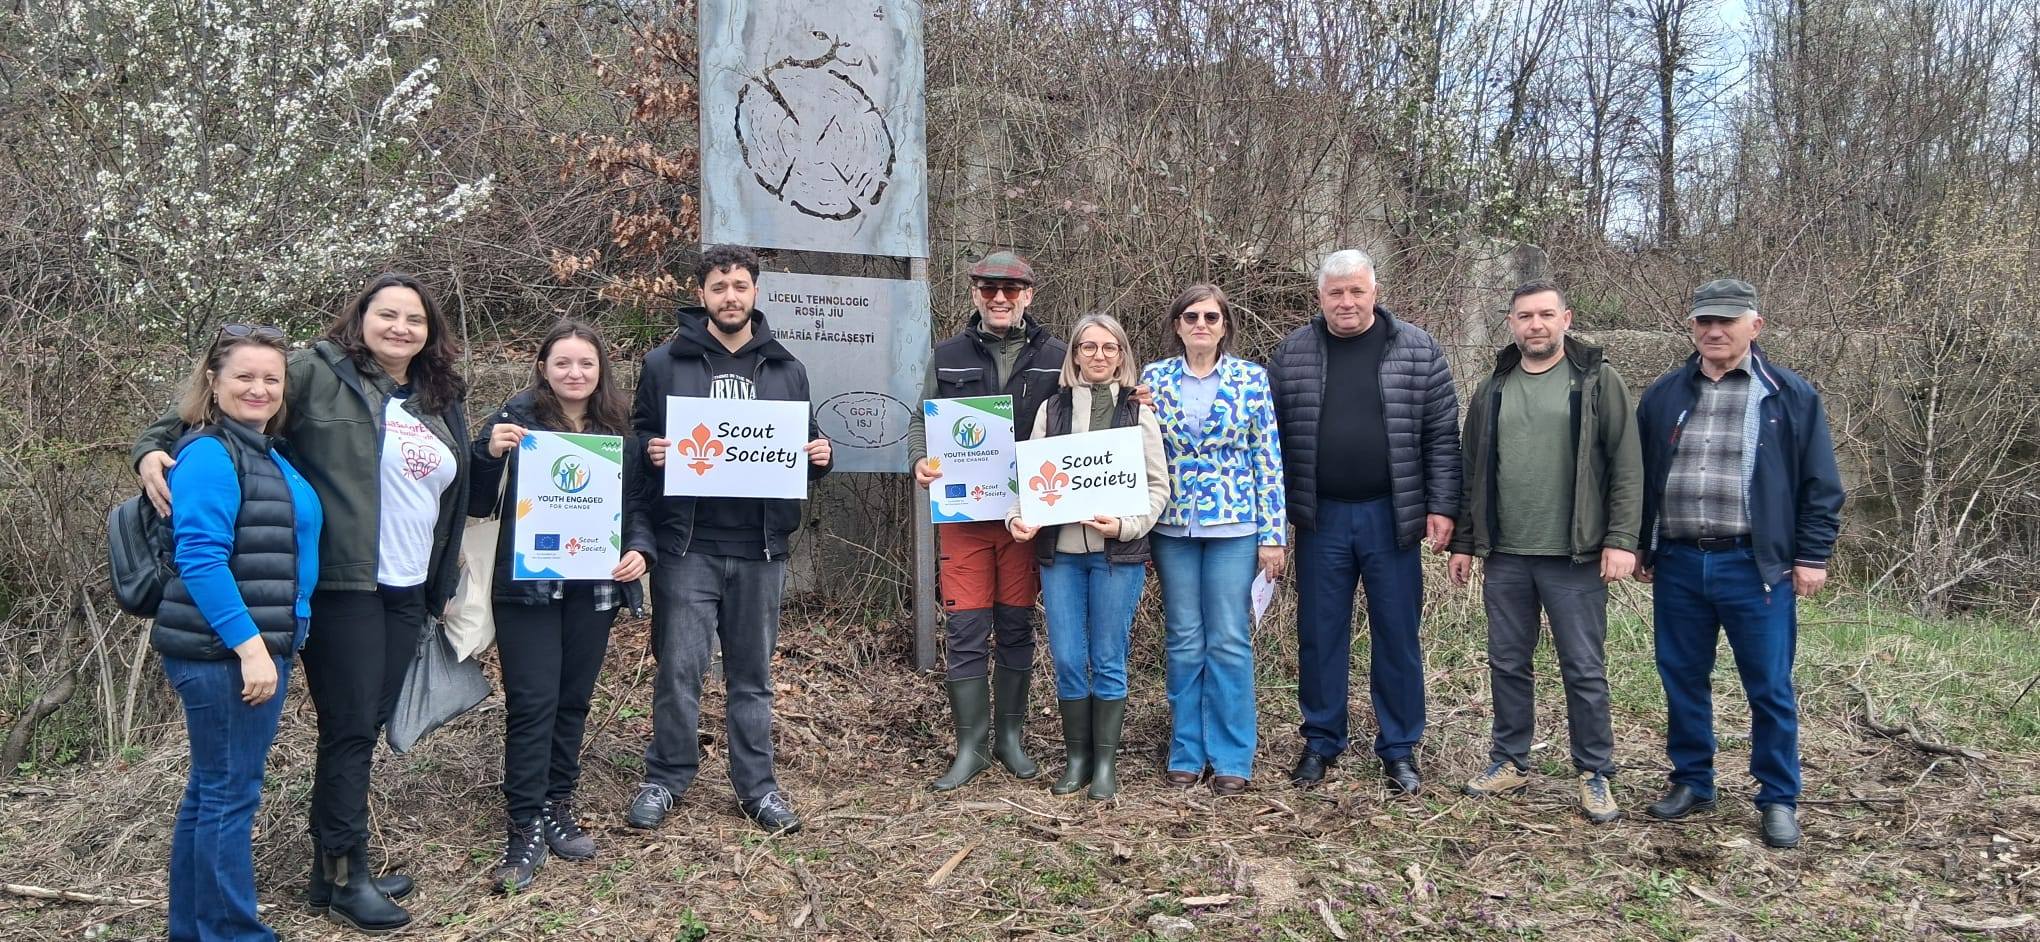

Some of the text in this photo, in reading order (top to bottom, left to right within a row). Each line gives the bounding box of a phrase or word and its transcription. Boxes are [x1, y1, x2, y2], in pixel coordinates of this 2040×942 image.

[710, 379, 757, 400] IRVANA
[850, 407, 878, 417] GORJ
[857, 419, 872, 428] ISJ
[717, 422, 775, 439] Scout
[725, 446, 797, 469] Society
[943, 451, 966, 459] YOUTH
[1062, 451, 1113, 470] Scout
[1071, 471, 1137, 490] Society
[537, 495, 604, 504] YOUTH ENGAGED
[581, 545, 607, 553] Society
